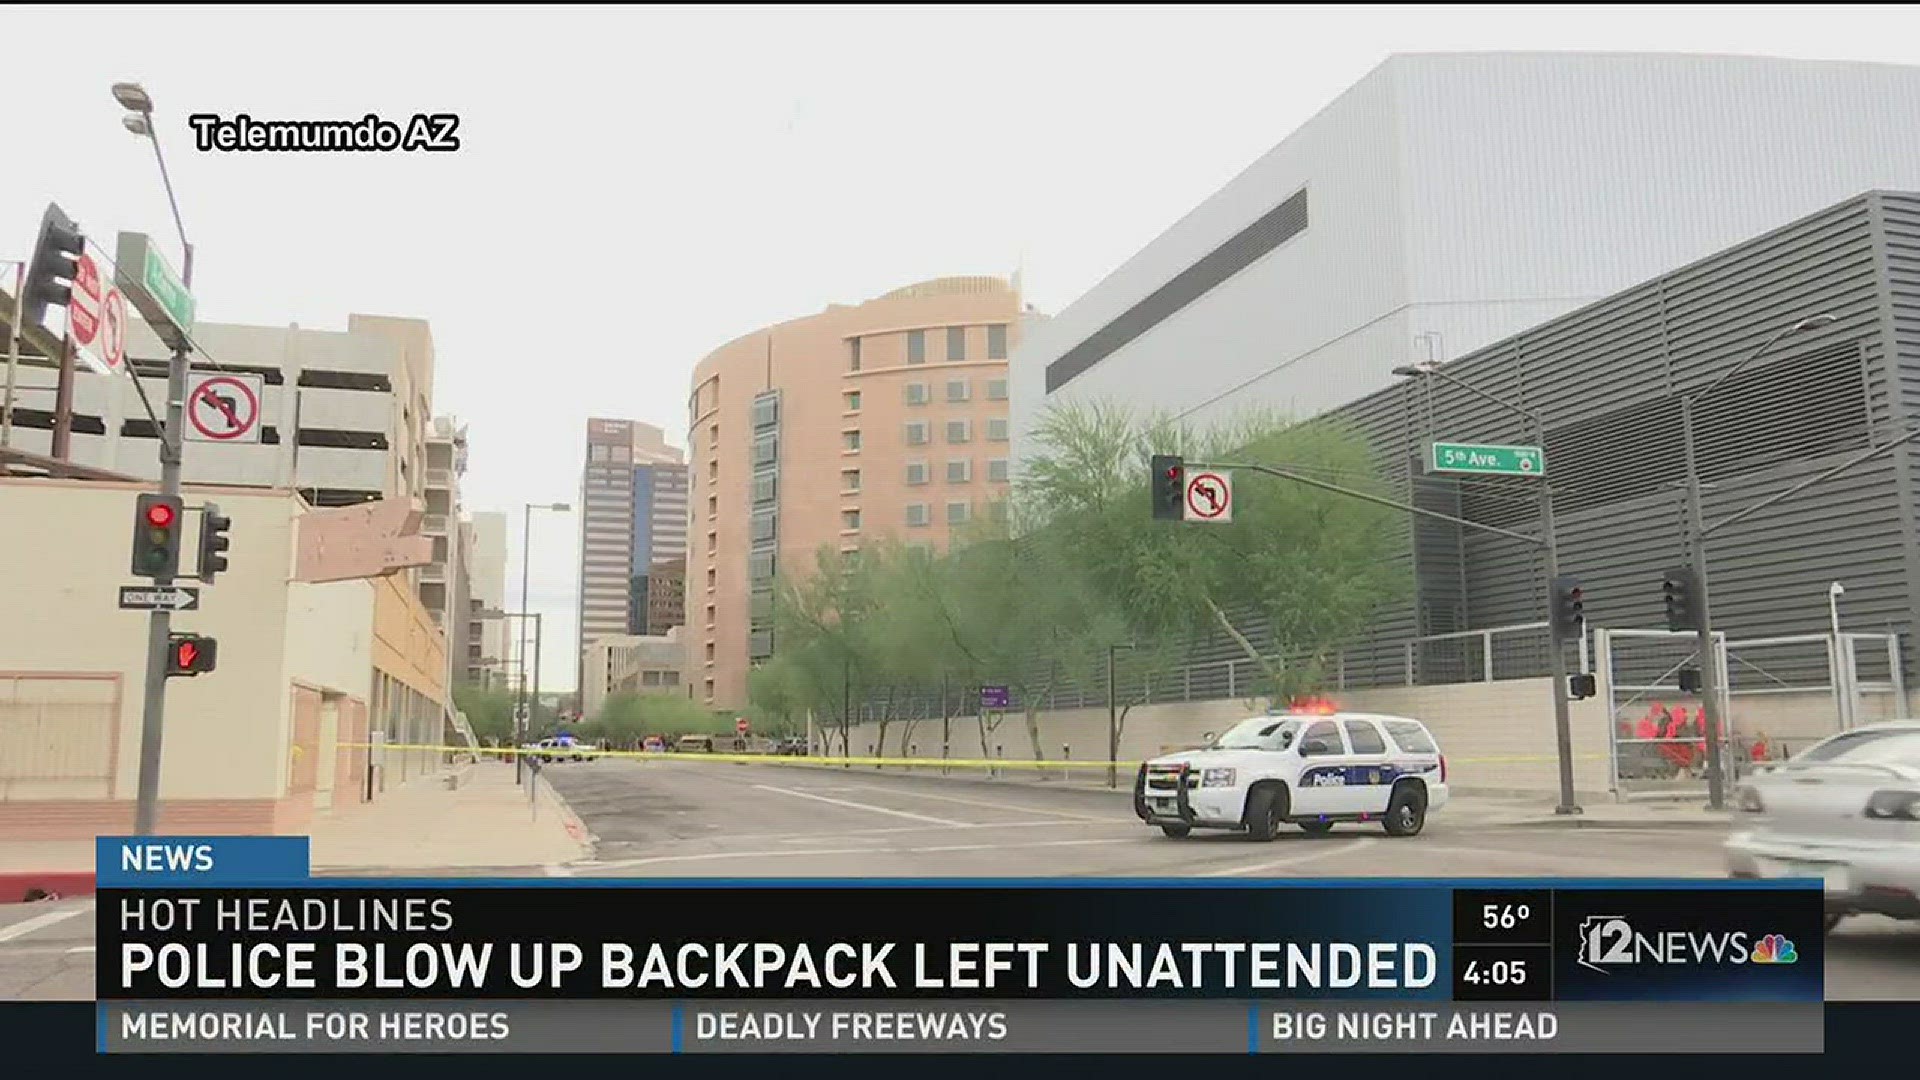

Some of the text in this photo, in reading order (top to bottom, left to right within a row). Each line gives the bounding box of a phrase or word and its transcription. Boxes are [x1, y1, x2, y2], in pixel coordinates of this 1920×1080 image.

[1444, 450, 1467, 465] 5th
[1468, 451, 1501, 467] Ave.
[126, 591, 149, 603] ONE
[1314, 772, 1346, 787] Police
